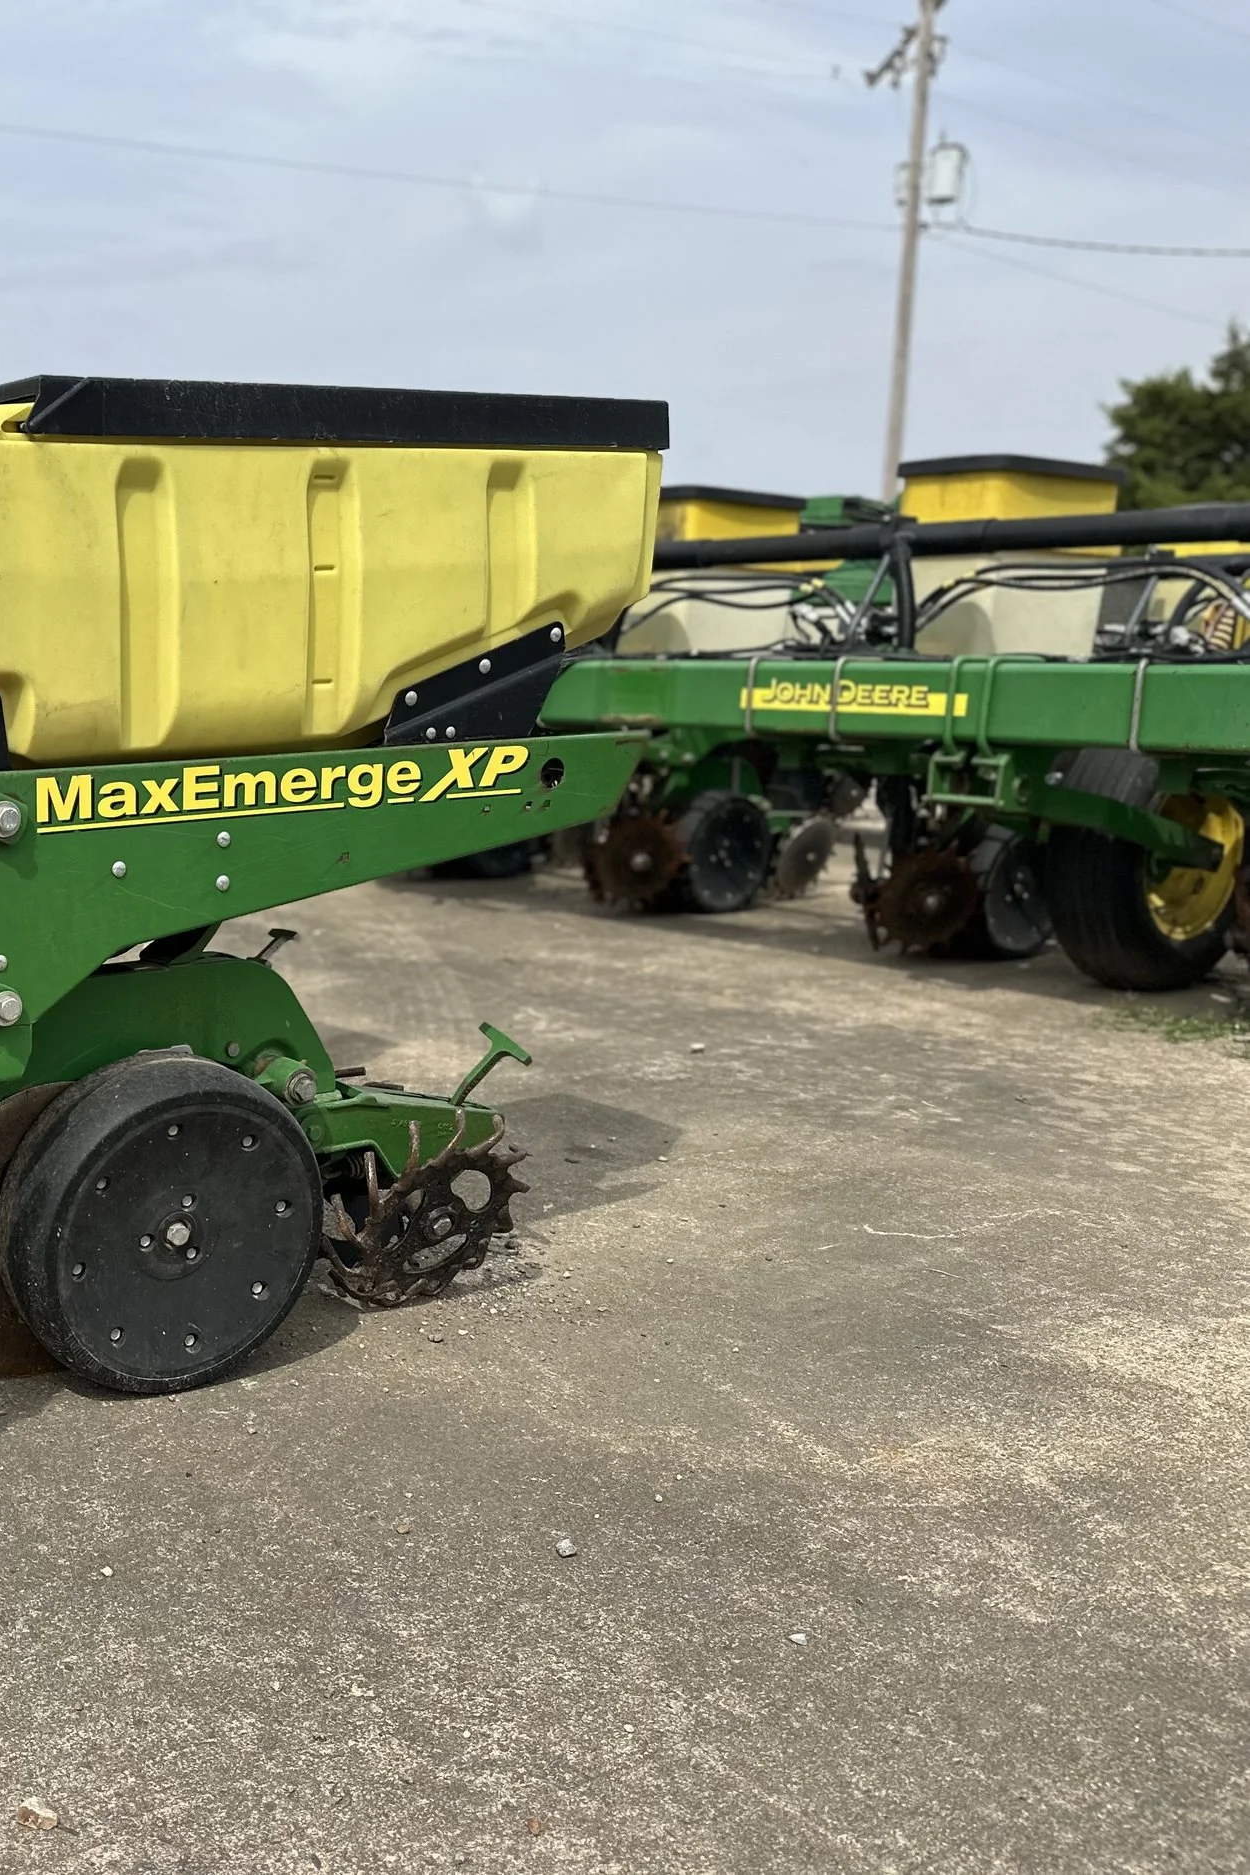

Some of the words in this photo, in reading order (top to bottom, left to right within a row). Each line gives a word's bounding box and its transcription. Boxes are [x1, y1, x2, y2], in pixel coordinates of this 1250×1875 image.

[761, 677, 832, 705] JOHN
[836, 678, 930, 708] DEERE
[35, 759, 423, 823] MaxEmerge
[417, 744, 530, 802] XP
